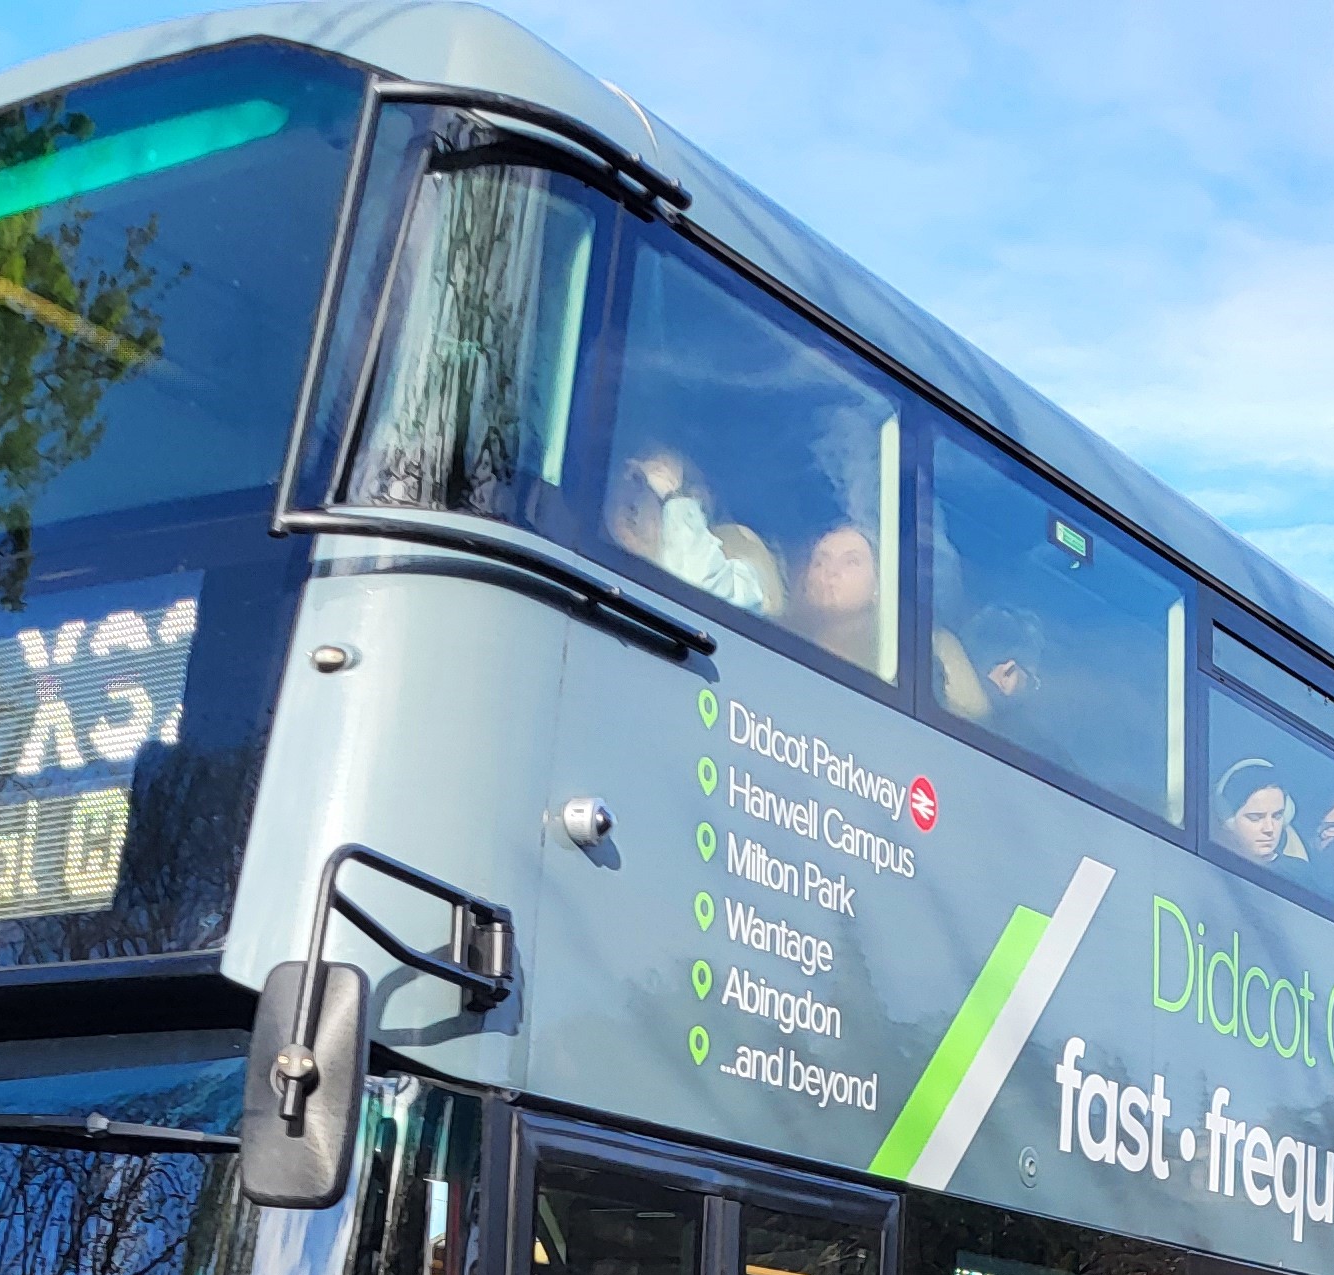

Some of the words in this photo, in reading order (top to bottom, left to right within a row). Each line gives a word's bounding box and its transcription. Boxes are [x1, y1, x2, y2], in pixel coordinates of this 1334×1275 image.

[728, 700, 810, 784] Didcot
[813, 737, 907, 821] Parkway
[728, 766, 819, 841] Harwell
[822, 808, 916, 879] Campus
[727, 832, 799, 897] Milton
[804, 862, 856, 918] Park
[724, 896, 833, 976] Wantage
[1153, 894, 1317, 1068] Didcot
[721, 966, 842, 1039] Abingdon
[788, 1050, 877, 1112] beyond
[1056, 1037, 1171, 1180] fast
